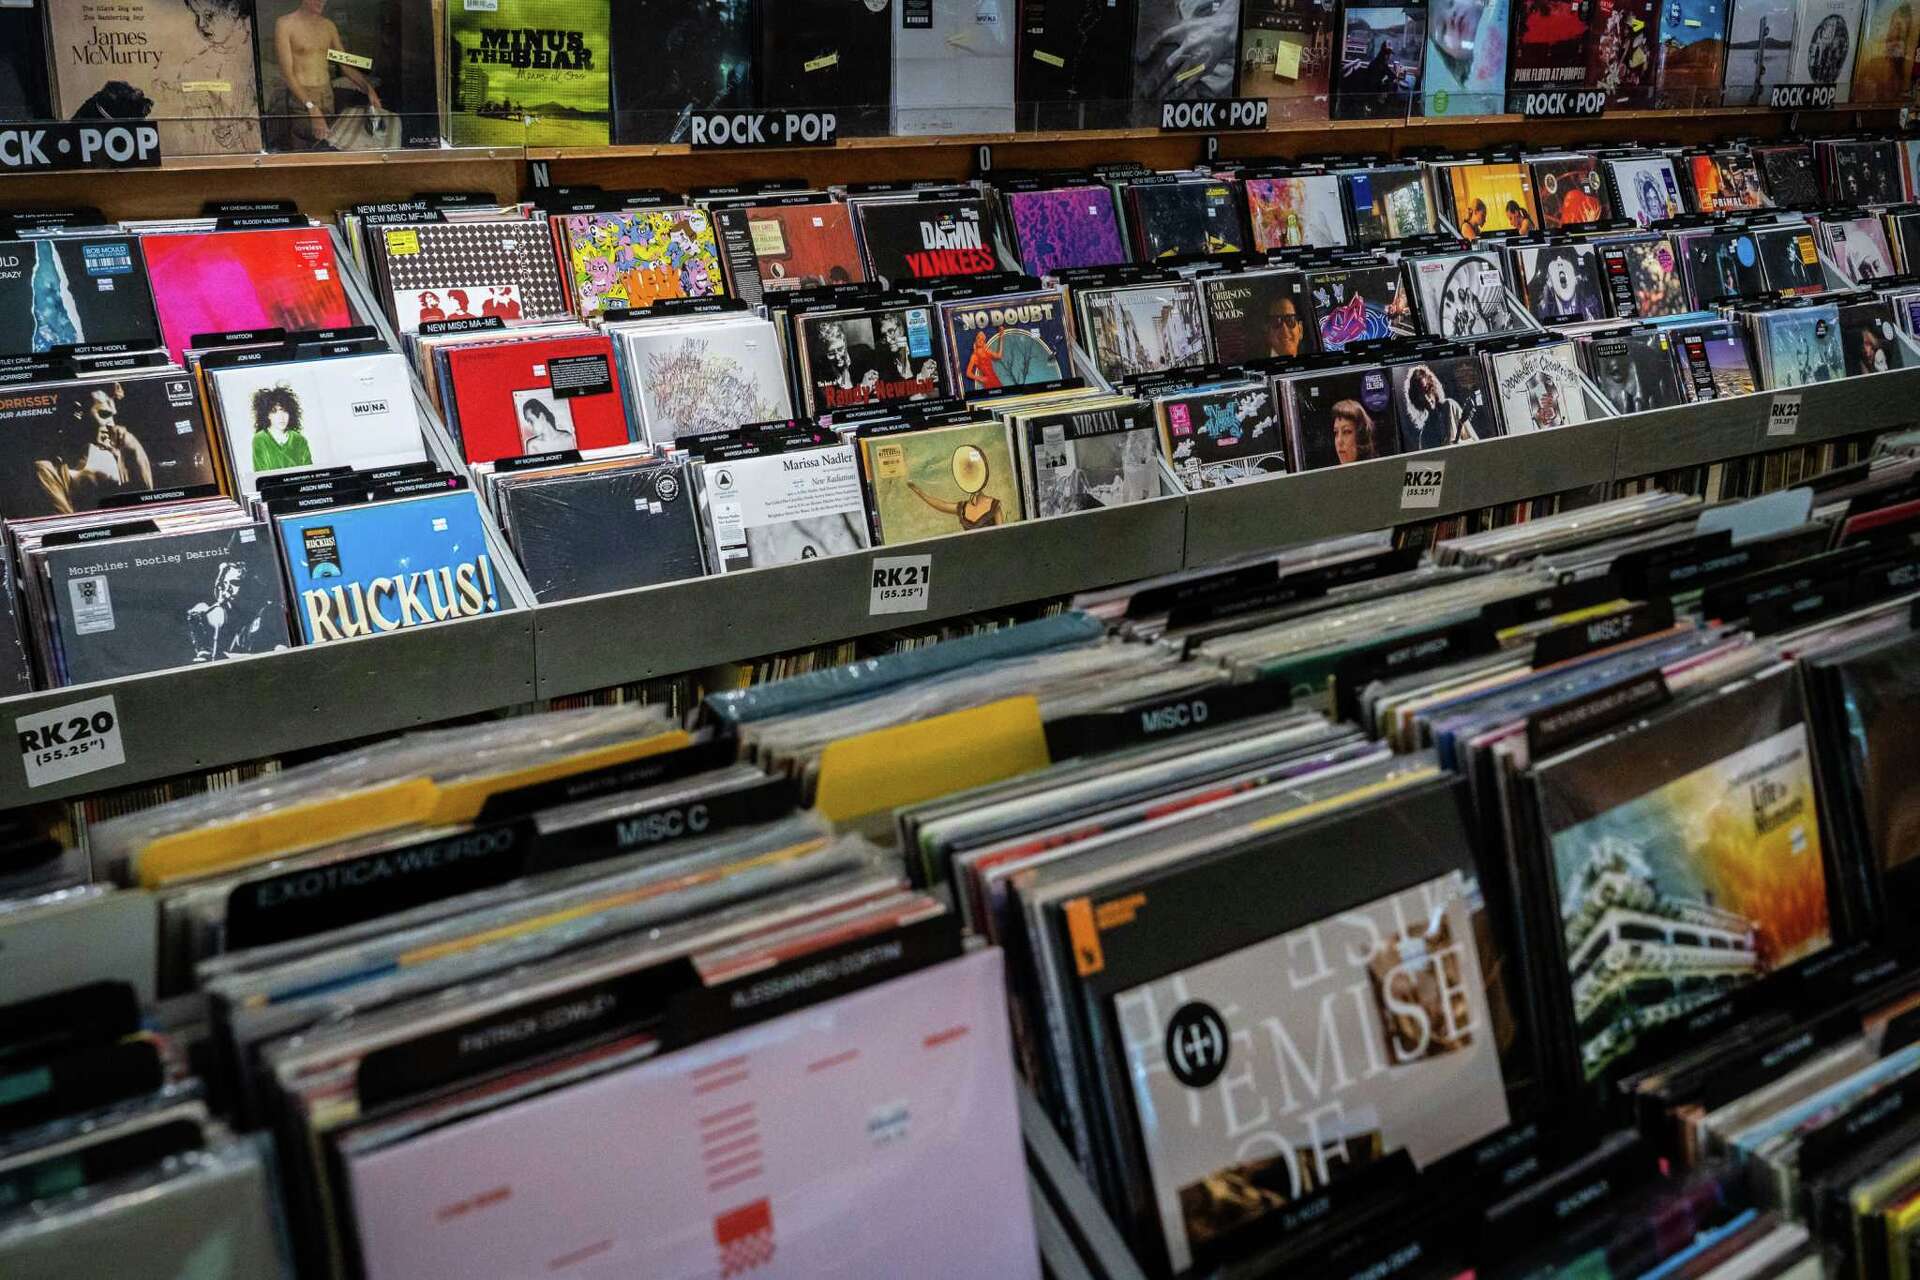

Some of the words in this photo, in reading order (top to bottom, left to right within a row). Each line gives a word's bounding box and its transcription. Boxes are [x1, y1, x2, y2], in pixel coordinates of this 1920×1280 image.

[87, 26, 148, 46] James
[479, 28, 584, 51] MINUS
[71, 44, 164, 69] McMurtry
[467, 48, 513, 64] THE
[511, 48, 595, 70] BEAR
[1525, 93, 1567, 115] ROCK
[1576, 92, 1606, 113] POP
[1771, 87, 1805, 107] ROCK
[1812, 86, 1836, 105] POP
[1162, 102, 1217, 128] ROCK
[1229, 101, 1268, 126] POP
[691, 114, 766, 145] ROCK
[785, 113, 836, 142] POP
[80, 127, 158, 162] POP
[1208, 137, 1218, 160] P
[532, 162, 550, 188] N
[357, 204, 377, 215] NEW
[377, 203, 399, 213] MISC
[366, 214, 386, 224] NEW
[386, 213, 408, 223] MISC
[919, 221, 982, 250] DAMN
[904, 243, 997, 278] YANKEES
[961, 310, 989, 331] NO
[991, 303, 1053, 327] DOUBT
[1213, 300, 1235, 311] MANY
[1215, 310, 1245, 321] MOODS
[426, 322, 447, 333] NEW
[447, 321, 468, 331] MISC
[94, 360, 116, 368] STEVE
[1771, 402, 1801, 417] RK23
[1072, 409, 1120, 437] NIRVANA
[783, 457, 821, 472] Marissa
[822, 453, 853, 465] Nadler
[372, 471, 401, 479] MUDHONEY
[1403, 471, 1442, 487] RK22
[140, 494, 157, 502] VAN
[157, 490, 185, 500] MORRISON
[300, 484, 316, 492] JASON
[316, 482, 333, 491] MRAZ
[394, 485, 415, 493] MOVING
[299, 496, 334, 507] MOVEMENTS
[78, 529, 112, 540] MORPHINE
[68, 560, 129, 577] Morphine:
[135, 552, 181, 568] Bootleg
[186, 546, 230, 560] Detroit
[872, 564, 930, 588] RK21
[301, 553, 498, 645] RUCKUS!
[1142, 706, 1191, 734] MISC
[1192, 701, 1208, 723] D
[17, 710, 114, 755] RK20
[615, 810, 684, 849] MISC
[686, 804, 710, 834] C
[1188, 942, 1482, 1138] EMISE
